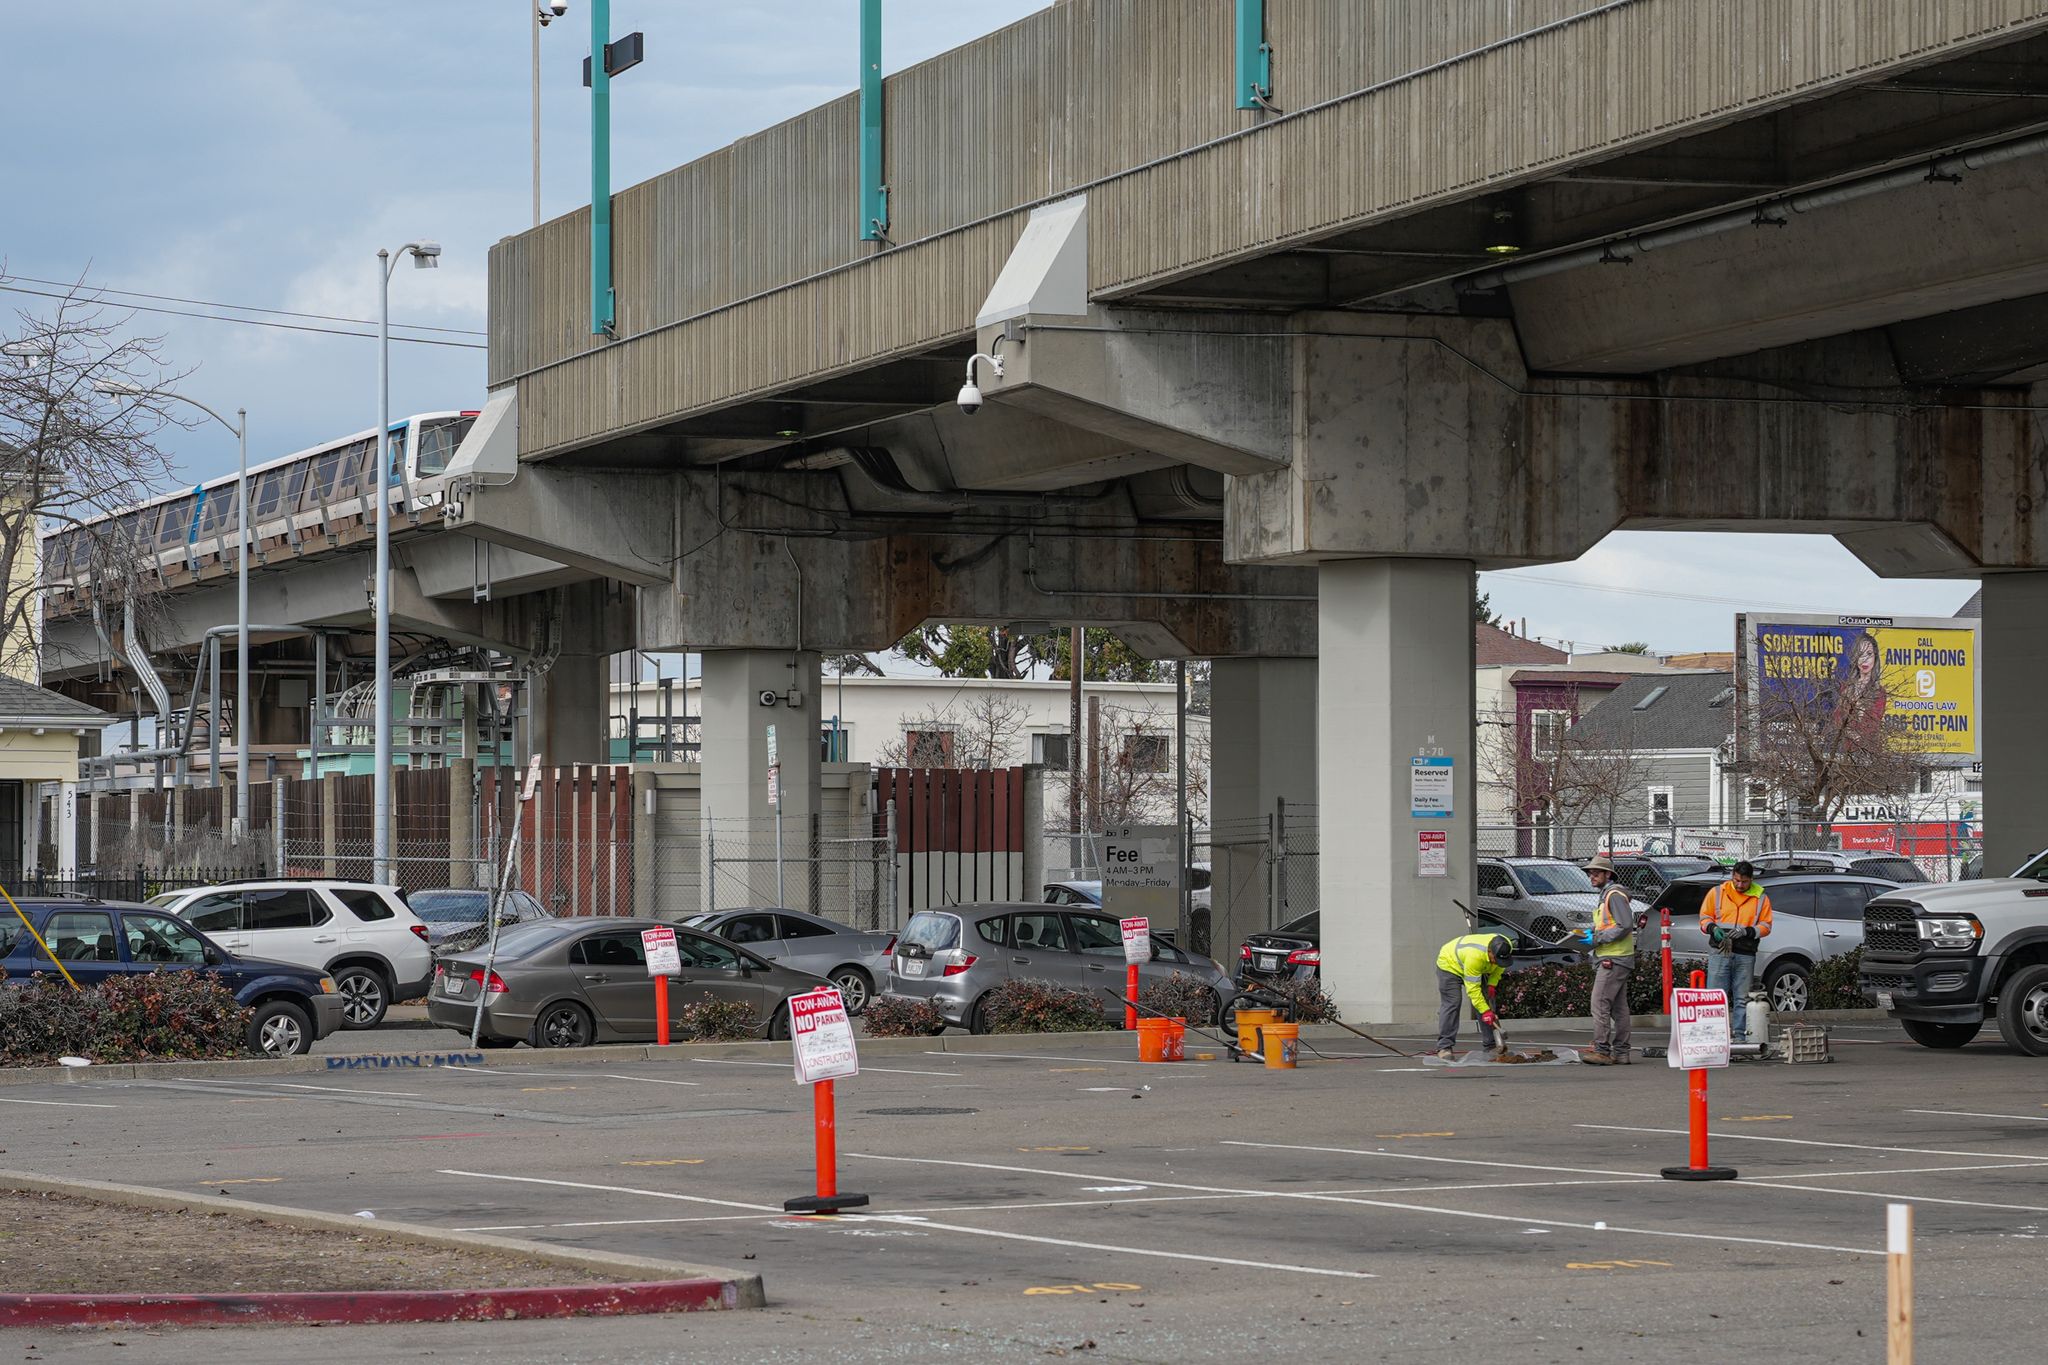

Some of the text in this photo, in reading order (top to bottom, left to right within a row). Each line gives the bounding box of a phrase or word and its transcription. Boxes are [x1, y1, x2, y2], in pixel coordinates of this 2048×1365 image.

[1763, 633, 1844, 654] SOMETHING
[1917, 637, 1934, 647] CALL
[1885, 648, 1966, 667] ANH PHOONG
[1763, 655, 1838, 680] WRONG?
[1894, 701, 1957, 710] PHOONG LAW
[1427, 735, 1435, 744] M
[1106, 846, 1139, 862] Fee
[1872, 922, 1897, 930] RAM
[644, 932, 672, 940] TOW-AWAY
[1123, 930, 1132, 938] NO
[645, 941, 657, 950] NO
[1678, 992, 1722, 1003] TOW-AWAY
[793, 995, 842, 1013] TOW-AWAY
[1679, 1006, 1725, 1021] NO PARKING
[796, 1012, 845, 1032] NO PARKING
[1682, 1045, 1728, 1056] CONSTRUCTION
[805, 1051, 854, 1068] CONSTRUCTION
